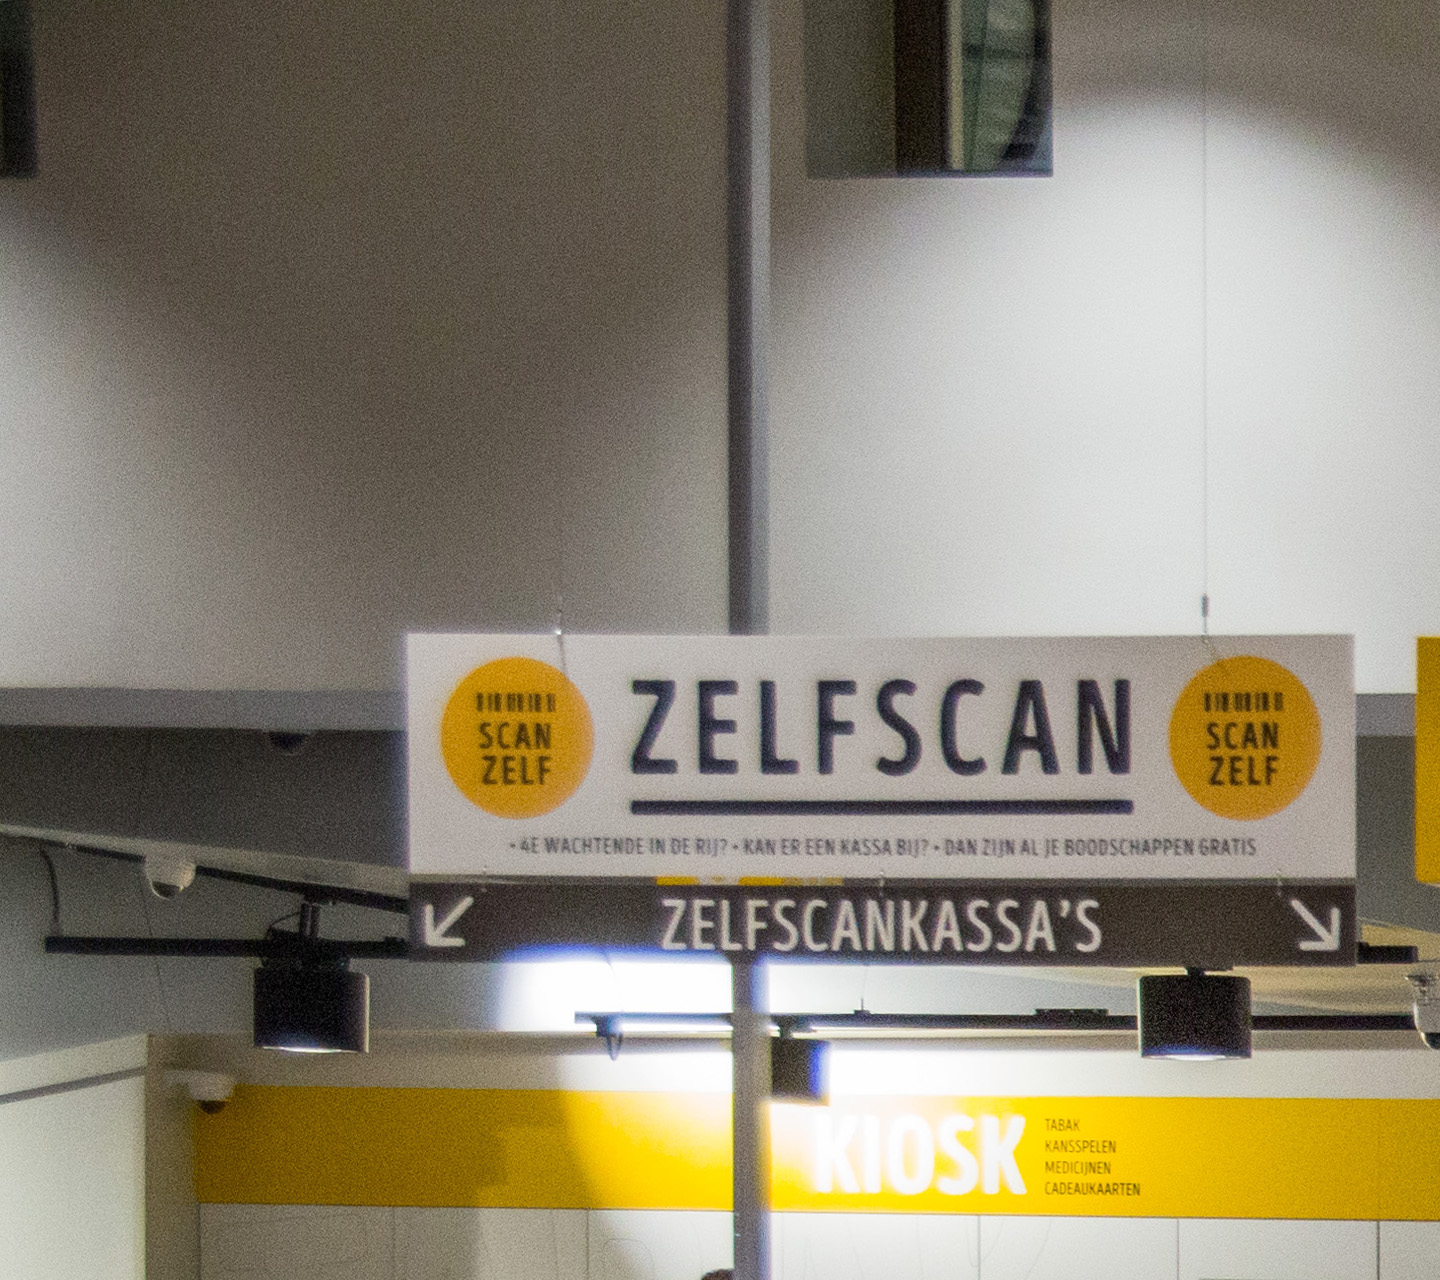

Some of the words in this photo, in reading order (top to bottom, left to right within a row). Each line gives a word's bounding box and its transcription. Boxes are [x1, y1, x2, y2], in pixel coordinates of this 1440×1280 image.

[478, 722, 552, 750] SCAN
[631, 679, 1132, 776] ZELFSCAN
[1206, 722, 1280, 750] SCAN
[481, 755, 552, 787] ZELF
[1208, 756, 1280, 787] ZELF
[544, 838, 645, 855] WACHTENDE
[650, 838, 666, 854] IN
[671, 838, 691, 854] DE
[743, 838, 776, 855] KAN
[780, 839, 801, 855] ER
[806, 839, 836, 855] EEN
[841, 838, 892, 856] KASSA
[945, 839, 978, 856] DAN
[982, 839, 1016, 857] ZIJN
[1019, 839, 1038, 856] AL
[1043, 839, 1060, 858] JE
[1064, 839, 1195, 857] BOODSCHAPPEN
[1199, 839, 1258, 857] GRATIS
[662, 899, 1103, 953] ZELFSCANKASSA'S
[1045, 1118, 1080, 1132] TABAK
[814, 1114, 1028, 1195] KIOSK
[1045, 1140, 1117, 1154] KANSSPELEN
[1045, 1161, 1112, 1176] MEDICIJNEN
[1045, 1181, 1141, 1197] CADEAUKAARTEN
